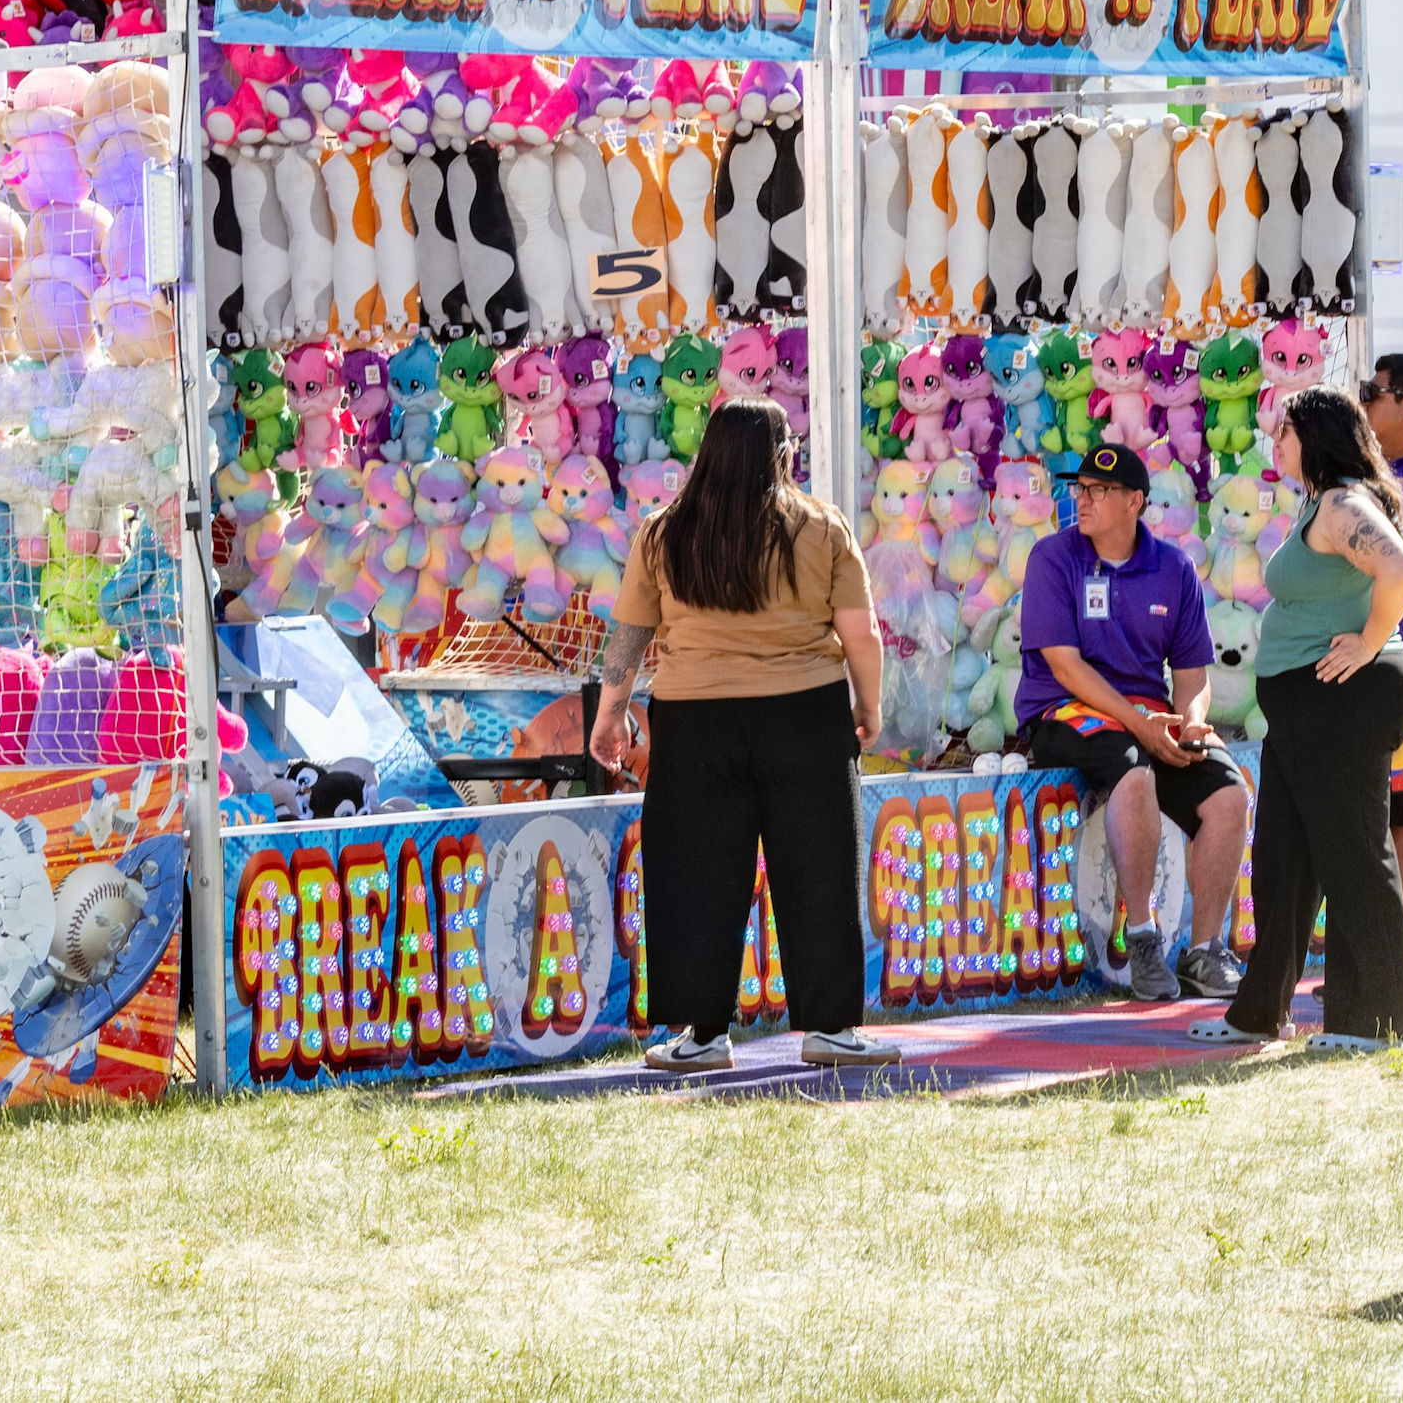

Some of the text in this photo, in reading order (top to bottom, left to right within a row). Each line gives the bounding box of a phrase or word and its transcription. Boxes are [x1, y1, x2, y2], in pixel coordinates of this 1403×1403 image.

[596, 249, 657, 296] 5
[233, 831, 495, 1085] BREAK
[521, 838, 588, 1040] A
[867, 781, 1086, 1009] BREAK
